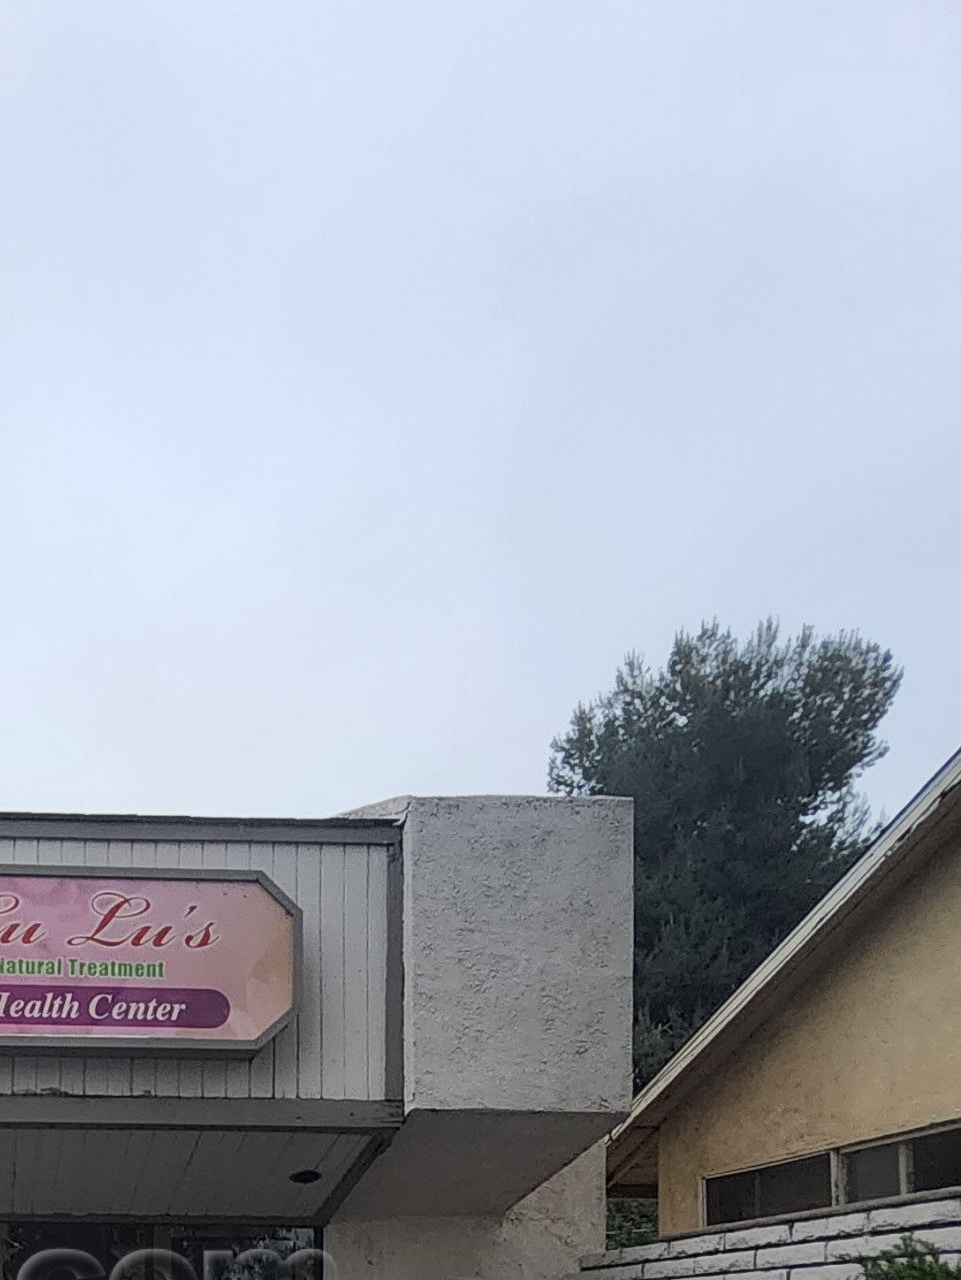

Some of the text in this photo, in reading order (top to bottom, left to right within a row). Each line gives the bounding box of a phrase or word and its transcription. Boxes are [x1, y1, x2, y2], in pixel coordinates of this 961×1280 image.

[67, 892, 220, 949] Lu's
[69, 958, 165, 979] Treatment
[89, 994, 186, 1022] Center
